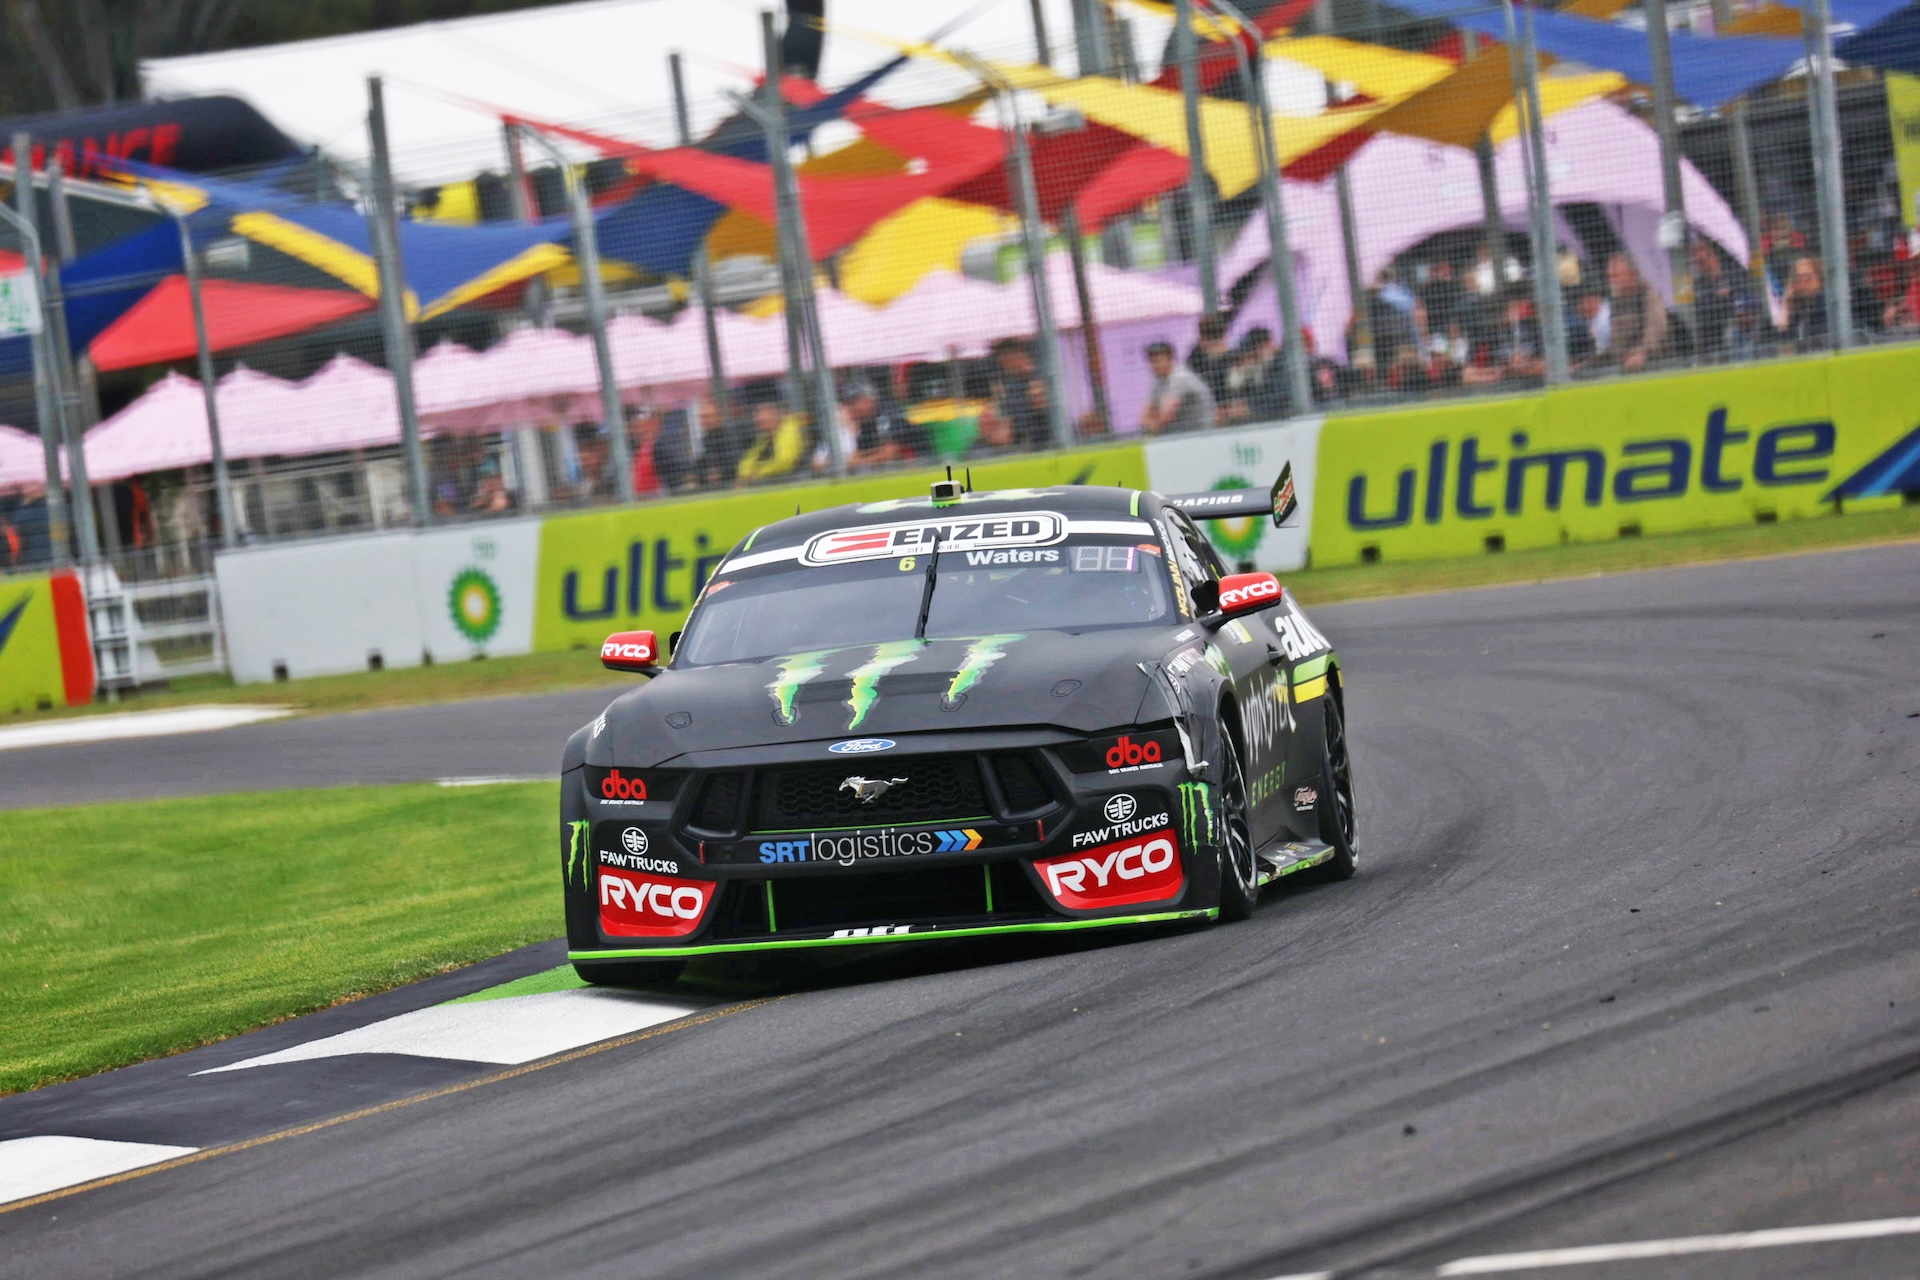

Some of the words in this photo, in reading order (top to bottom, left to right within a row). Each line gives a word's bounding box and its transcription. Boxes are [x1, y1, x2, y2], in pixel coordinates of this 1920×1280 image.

[1347, 406, 1837, 531] ultimate
[893, 520, 1040, 546] ENZED
[899, 556, 916, 571] 6
[966, 549, 1060, 566] Waters
[1219, 580, 1278, 607] RYCO
[601, 643, 651, 659] RYCO
[1106, 736, 1161, 768] dba
[602, 769, 647, 800] dba
[1072, 827, 1111, 847] FAW
[1111, 812, 1169, 838] TRUCKS
[600, 850, 628, 867] FAW
[628, 855, 679, 874] TRUCKS
[1047, 838, 1174, 897] RYCO
[600, 874, 703, 920] RYCO
